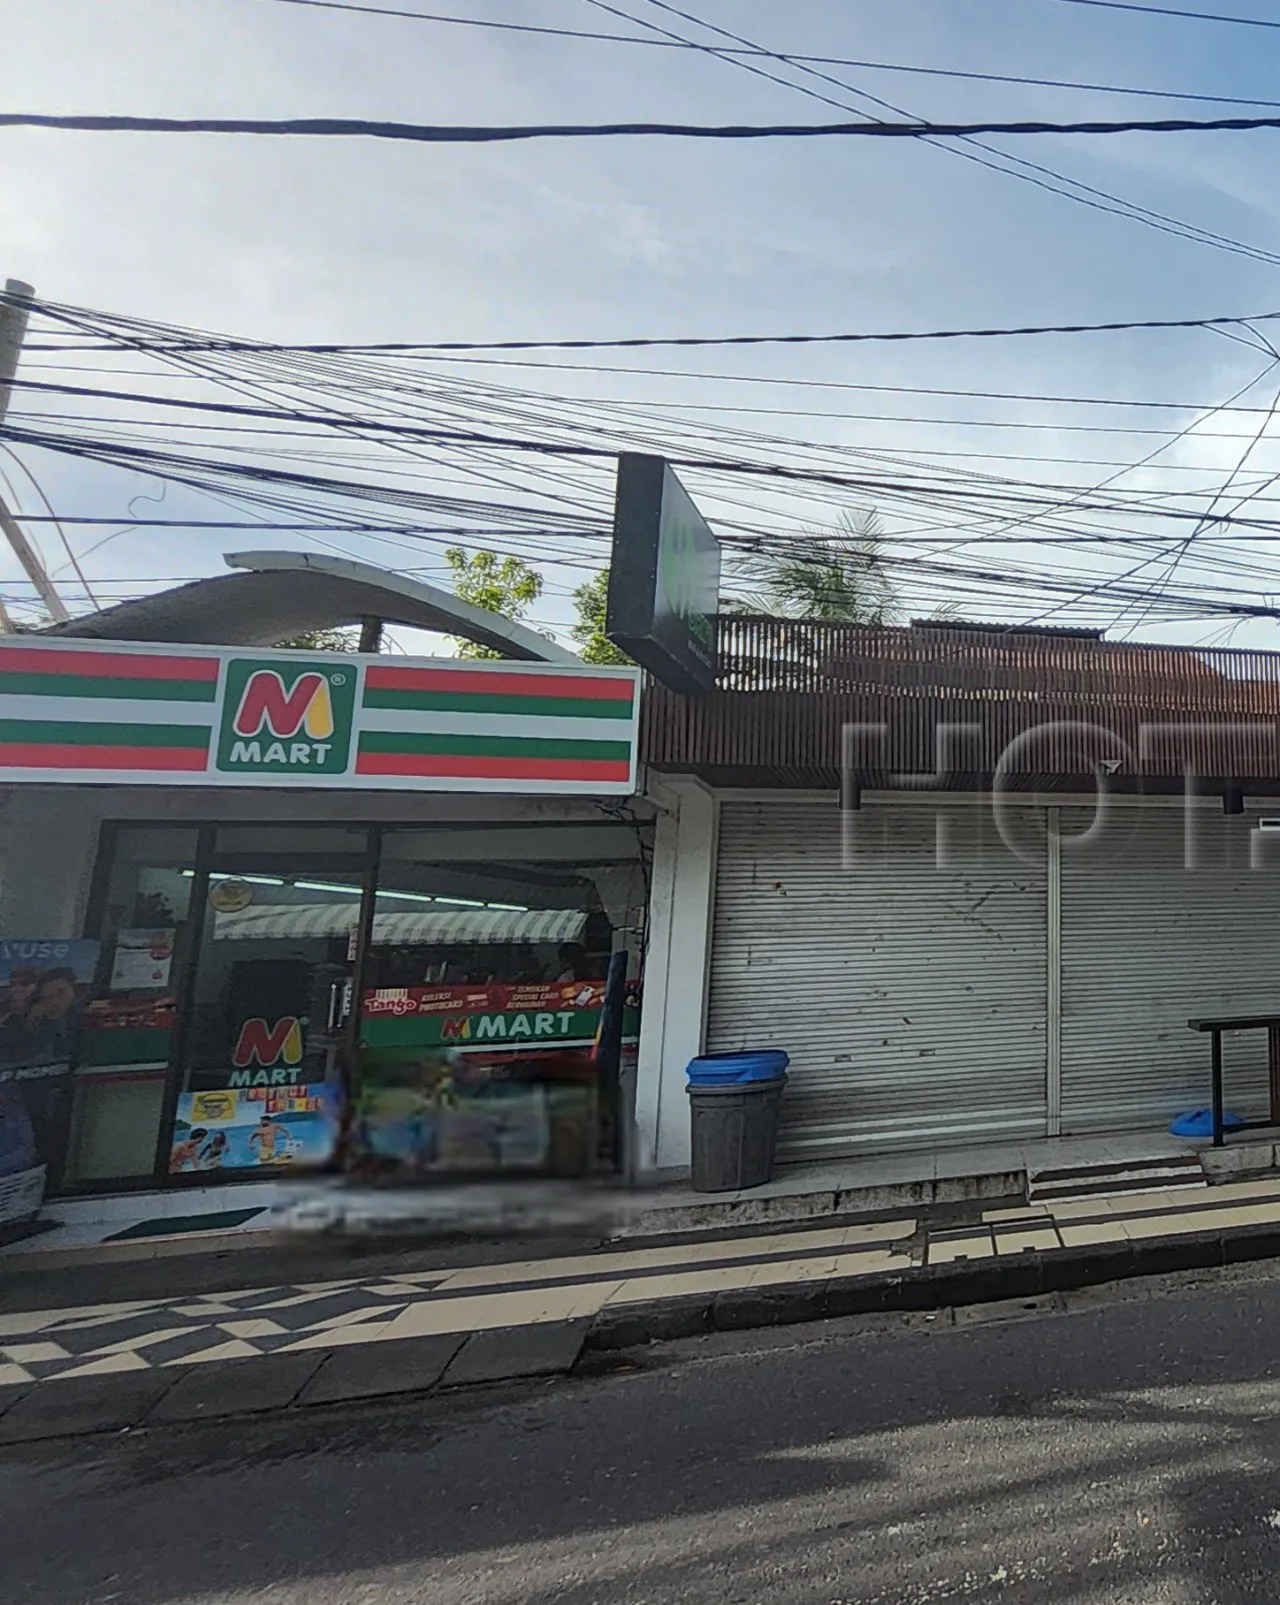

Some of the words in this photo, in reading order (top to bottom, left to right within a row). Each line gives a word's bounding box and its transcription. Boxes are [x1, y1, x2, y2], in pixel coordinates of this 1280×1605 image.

[232, 669, 334, 740] M
[229, 741, 332, 764] MART
[364, 997, 417, 1015] Tango
[441, 1015, 471, 1040] M
[476, 1012, 576, 1038] MART
[232, 1016, 303, 1067] M
[227, 1068, 303, 1087] MART
